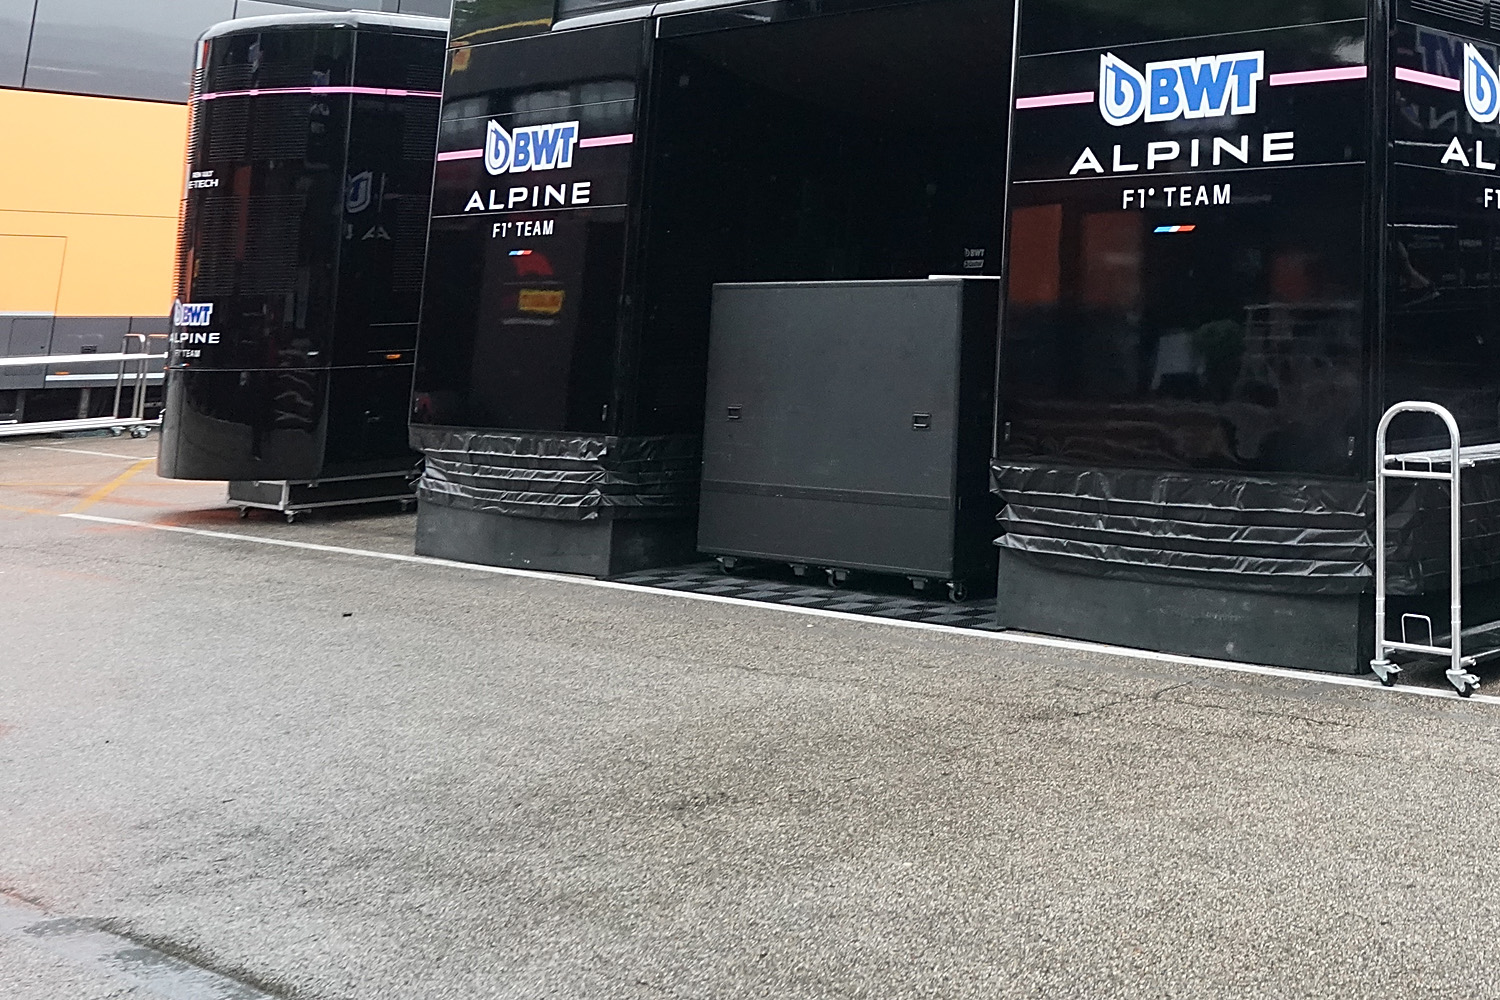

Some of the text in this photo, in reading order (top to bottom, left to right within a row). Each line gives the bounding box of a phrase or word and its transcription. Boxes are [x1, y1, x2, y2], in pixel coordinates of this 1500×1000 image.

[1144, 50, 1264, 122] BWT
[509, 121, 579, 173] BWT
[1069, 131, 1294, 175] ALPINE
[464, 182, 591, 212] ALPINE
[1163, 184, 1231, 207] TEAM
[515, 220, 554, 236] TEAM
[181, 303, 213, 326] BWT
[169, 332, 220, 344] ALPINE
